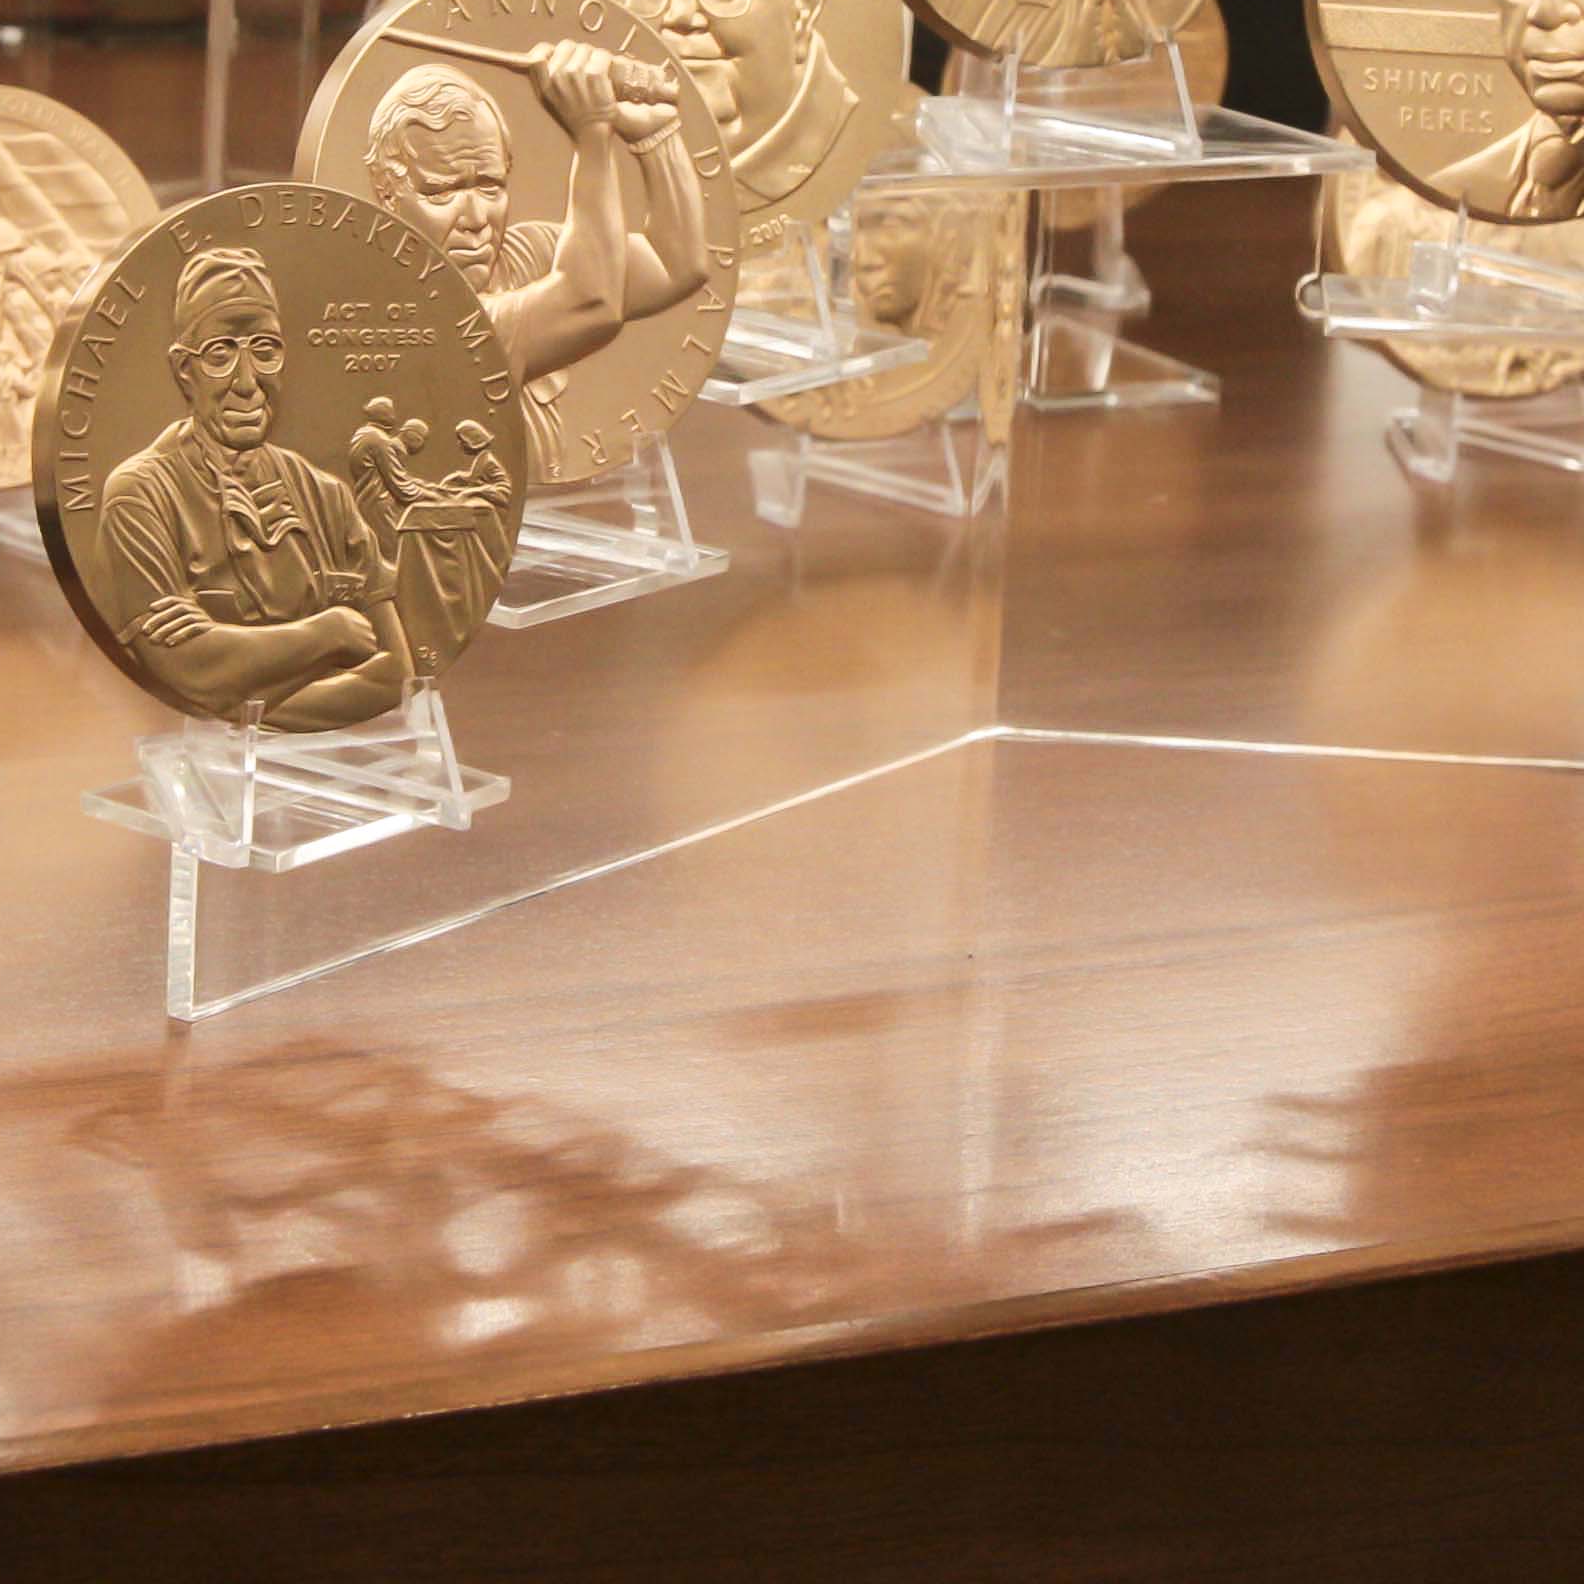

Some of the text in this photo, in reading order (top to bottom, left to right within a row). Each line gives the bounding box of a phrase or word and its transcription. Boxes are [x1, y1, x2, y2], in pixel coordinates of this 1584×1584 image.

[1362, 65, 1494, 97] SHIMON
[1399, 104, 1494, 135] PERES
[322, 302, 419, 321] ACT OF
[305, 327, 436, 347] CONGRESS
[59, 275, 146, 513] MICHAEL
[168, 219, 212, 255] E.
[343, 353, 401, 373] 2007
[581, 244, 736, 466] PALMER
